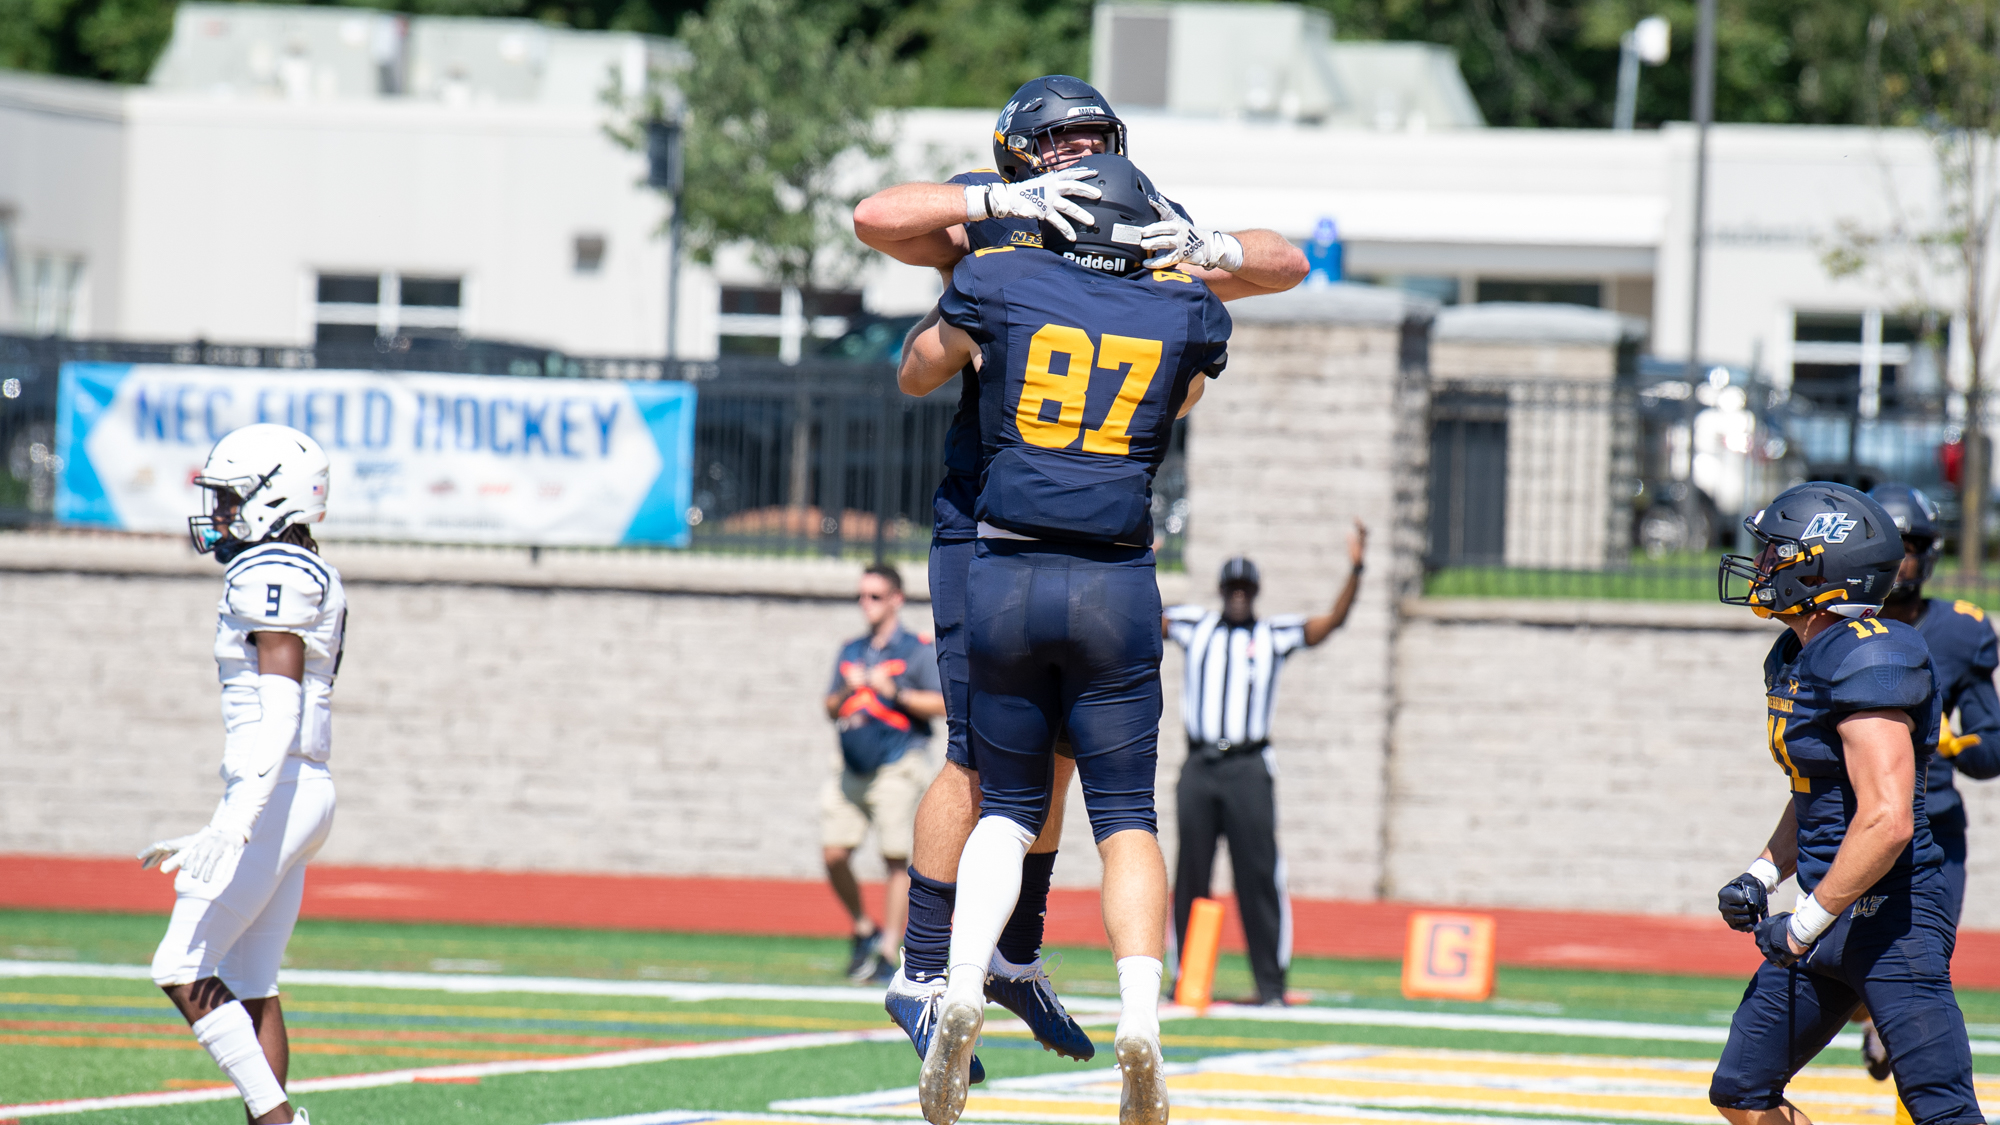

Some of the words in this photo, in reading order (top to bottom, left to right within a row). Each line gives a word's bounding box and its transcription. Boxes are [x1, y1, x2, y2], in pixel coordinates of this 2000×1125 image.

[1019, 190, 1048, 212] adidas
[1062, 251, 1126, 272] Riddell
[1182, 239, 1205, 258] adidas
[1015, 323, 1163, 456] 87
[134, 383, 232, 442] NEC
[255, 387, 394, 448] FIELD
[413, 390, 620, 459] HOCKEY
[1800, 512, 1858, 544] MC
[265, 583, 282, 617] 9
[1847, 617, 1890, 640] 11
[1427, 923, 1471, 979] G
